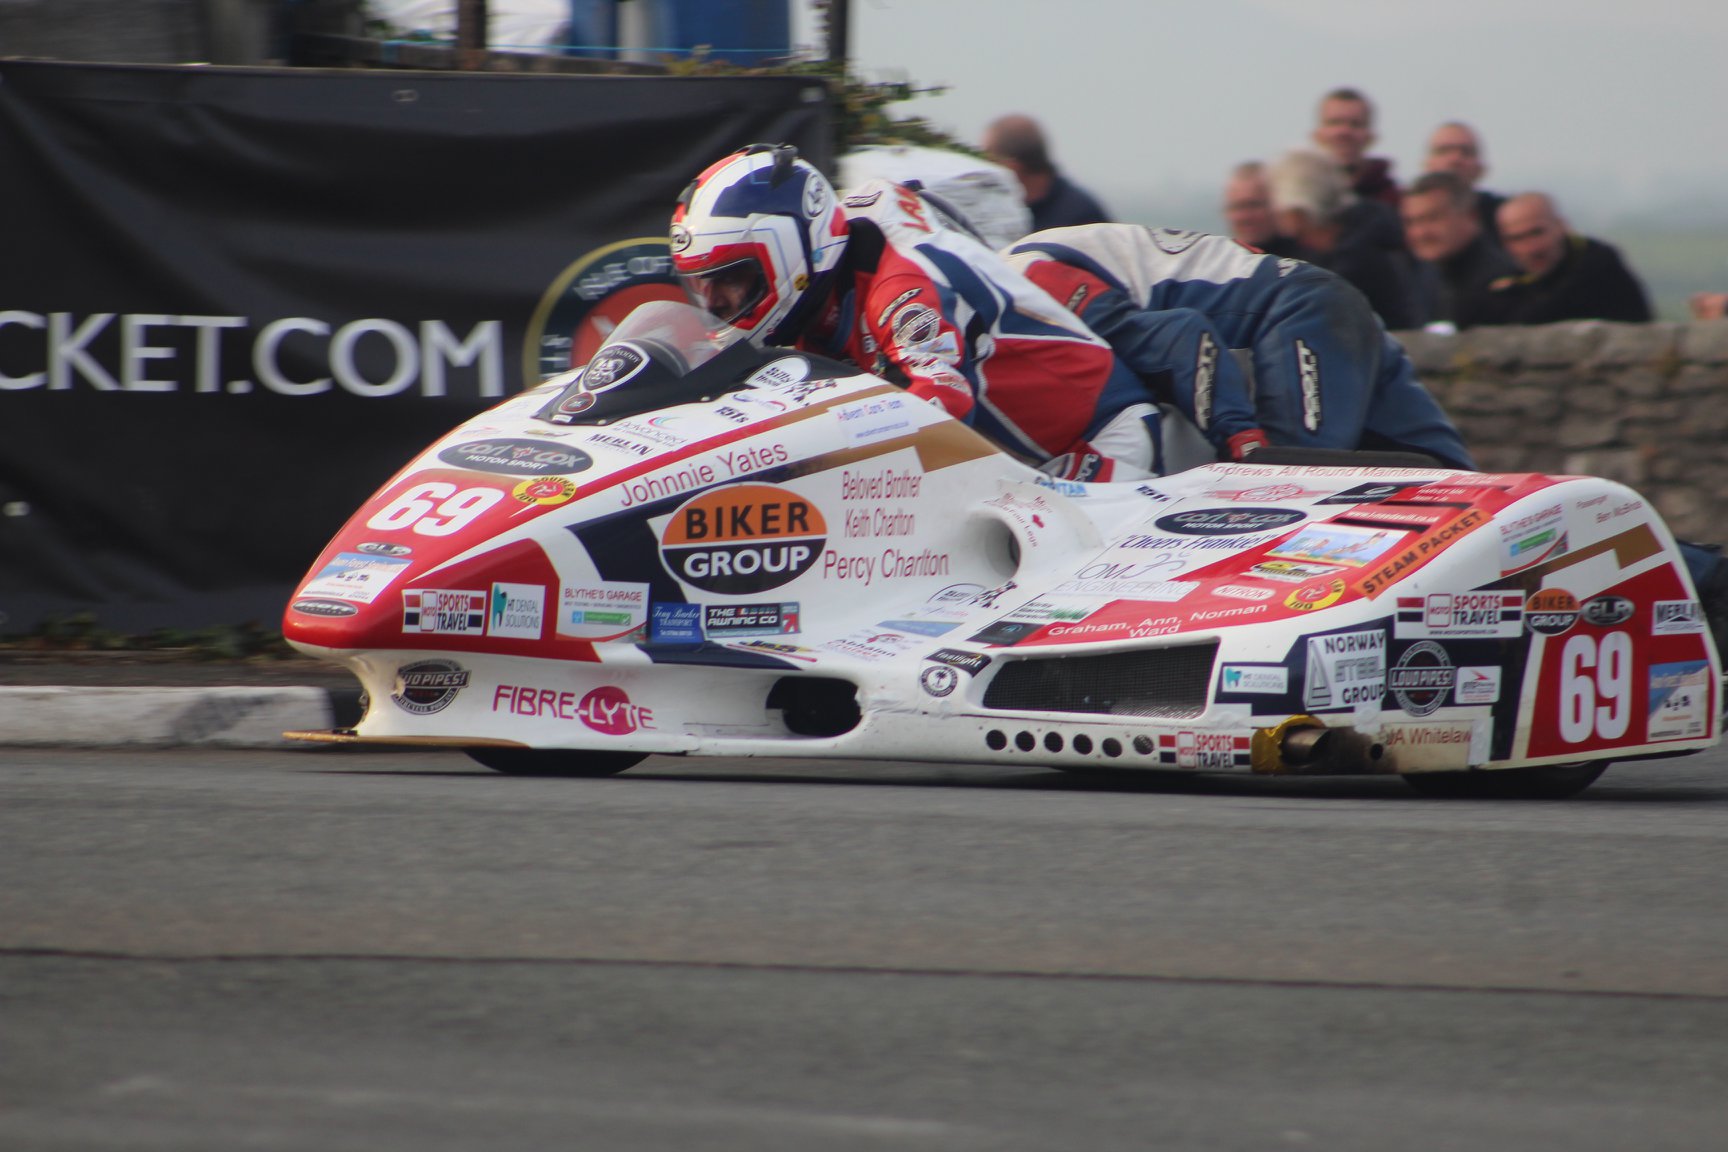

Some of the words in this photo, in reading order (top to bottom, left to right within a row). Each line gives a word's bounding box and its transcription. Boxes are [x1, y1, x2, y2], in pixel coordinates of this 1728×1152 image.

[586, 433, 655, 456] MERLIN
[467, 455, 509, 467] MOTOR
[510, 458, 549, 470] SPORT
[621, 463, 715, 506] Johnnie
[717, 444, 788, 476] Yates
[842, 471, 883, 500] Beloved
[885, 469, 922, 499] Brother
[366, 482, 506, 538] 69
[686, 501, 810, 539] BIKER
[845, 510, 871, 538] Keith
[684, 546, 810, 578] GROUP
[1362, 549, 1418, 595] STEAM
[1420, 510, 1483, 553] PACKET
[824, 550, 876, 586] Percy
[564, 588, 604, 599] BLYTHE'S
[606, 590, 642, 601] GARAGE
[1056, 580, 1194, 594] ENGINEERING
[1217, 585, 1268, 598] NITRON
[438, 592, 469, 612] SPORTS
[1454, 595, 1500, 610] SPORTS
[1533, 596, 1573, 610] BIKER
[1588, 600, 1629, 617] GLR
[436, 612, 468, 631] TRAVEL
[707, 616, 756, 627] AWNING
[759, 615, 778, 625] CO
[709, 608, 736, 617] THE
[1048, 615, 1132, 637] Graham,
[1140, 614, 1182, 628] Ann,
[1190, 604, 1267, 622] Norman
[1452, 609, 1500, 626] TRAVEL
[1530, 614, 1575, 627] GROUP
[1129, 623, 1181, 639] Ward
[1325, 632, 1386, 654] NORWAY
[1335, 655, 1385, 682] STEEL
[1392, 670, 1419, 686] LOUD
[422, 672, 466, 686] PIPES!
[1559, 631, 1633, 744] 69
[1342, 685, 1386, 704] GROUP
[491, 684, 658, 731] FIBRE-LYTE
[1196, 734, 1232, 751] SPORTS
[1196, 751, 1234, 768] TRAVEL
